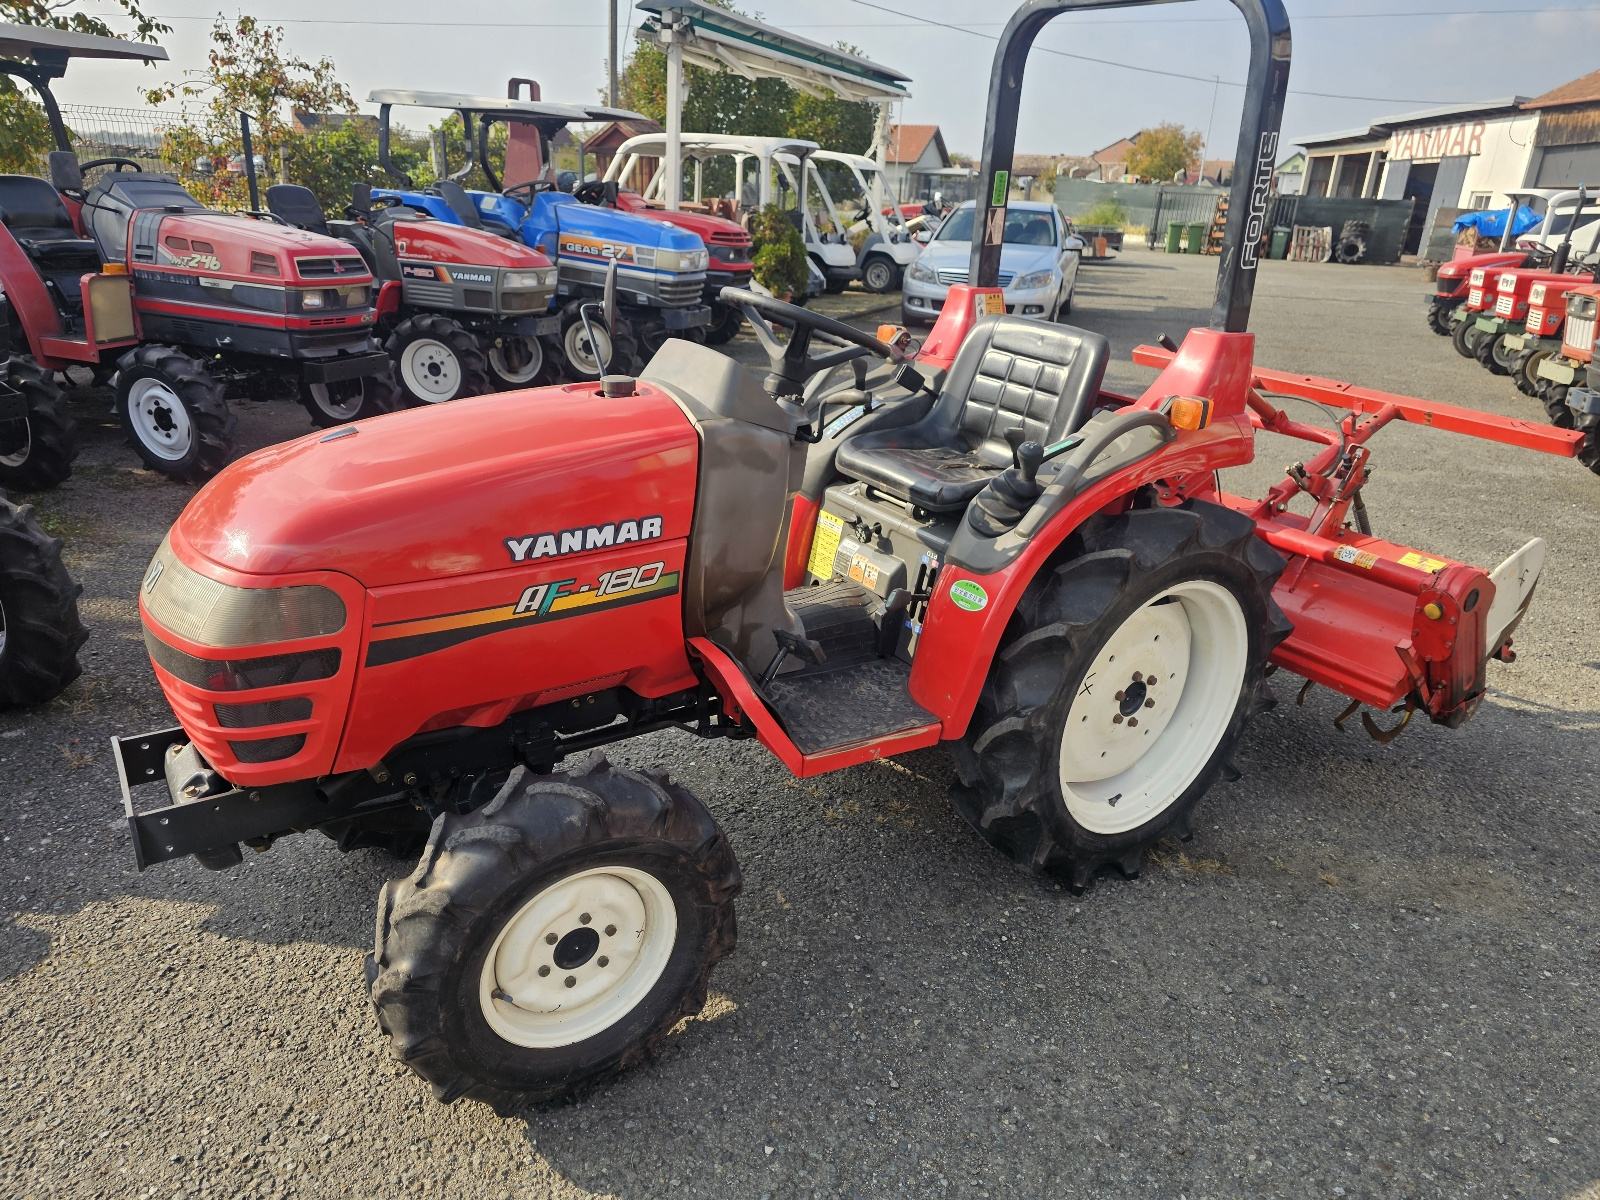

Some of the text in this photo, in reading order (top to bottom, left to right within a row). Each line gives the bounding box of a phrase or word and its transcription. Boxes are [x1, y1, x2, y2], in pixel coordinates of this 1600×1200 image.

[1393, 121, 1486, 160] YANMAR
[1240, 131, 1279, 270] FORTE
[566, 243, 628, 259] GEAS 27
[451, 271, 492, 283] YANMAR
[506, 516, 662, 562] YANMAR
[513, 561, 665, 616] AF-180
